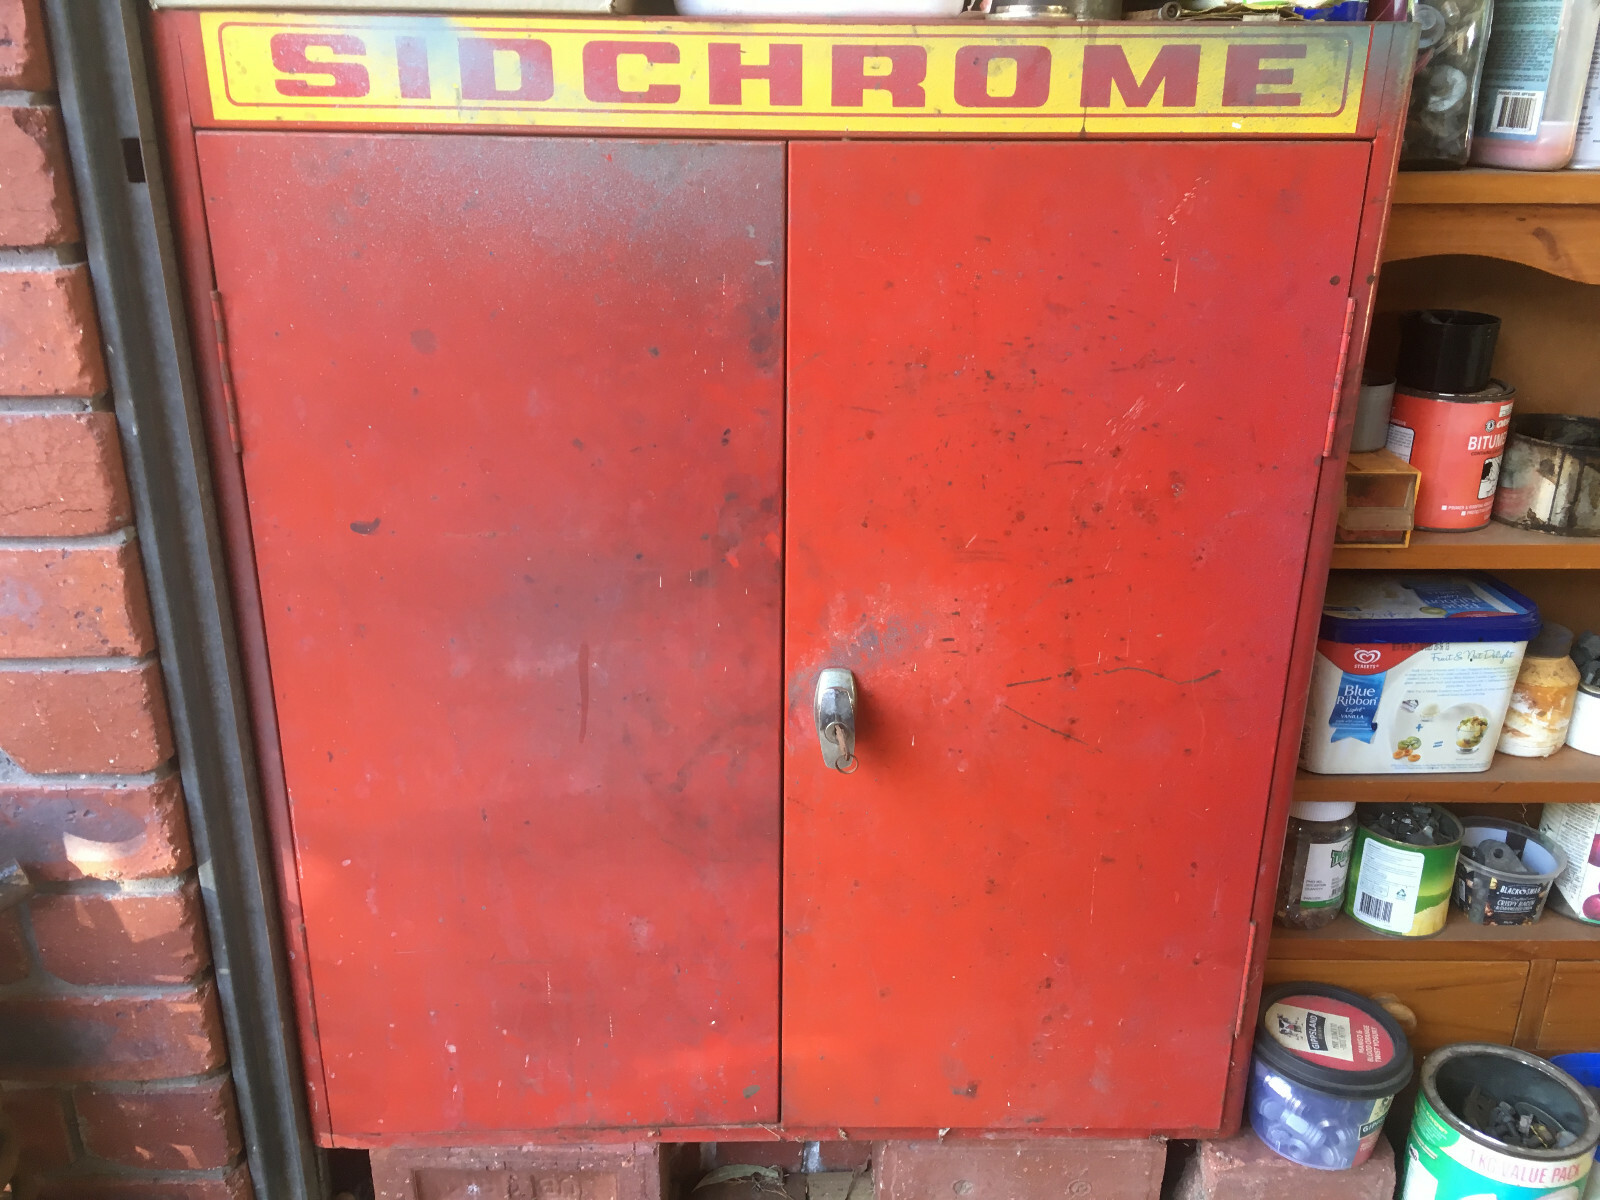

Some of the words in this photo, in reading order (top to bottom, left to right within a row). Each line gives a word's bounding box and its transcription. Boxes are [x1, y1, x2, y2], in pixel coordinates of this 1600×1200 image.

[270, 33, 1307, 108] SIDCHROME
[1431, 651, 1454, 662] Fruit
[1454, 652, 1463, 660] &
[1465, 650, 1483, 660] Nut
[1484, 649, 1516, 664] Delight
[1344, 684, 1376, 697] Blue
[1336, 695, 1377, 707] Ribbon
[1500, 885, 1519, 895] BLACK
[1309, 1014, 1320, 1050] GIPPSLAND
[1502, 1163, 1548, 1184] VALUE
[1550, 1163, 1581, 1184] PACK
